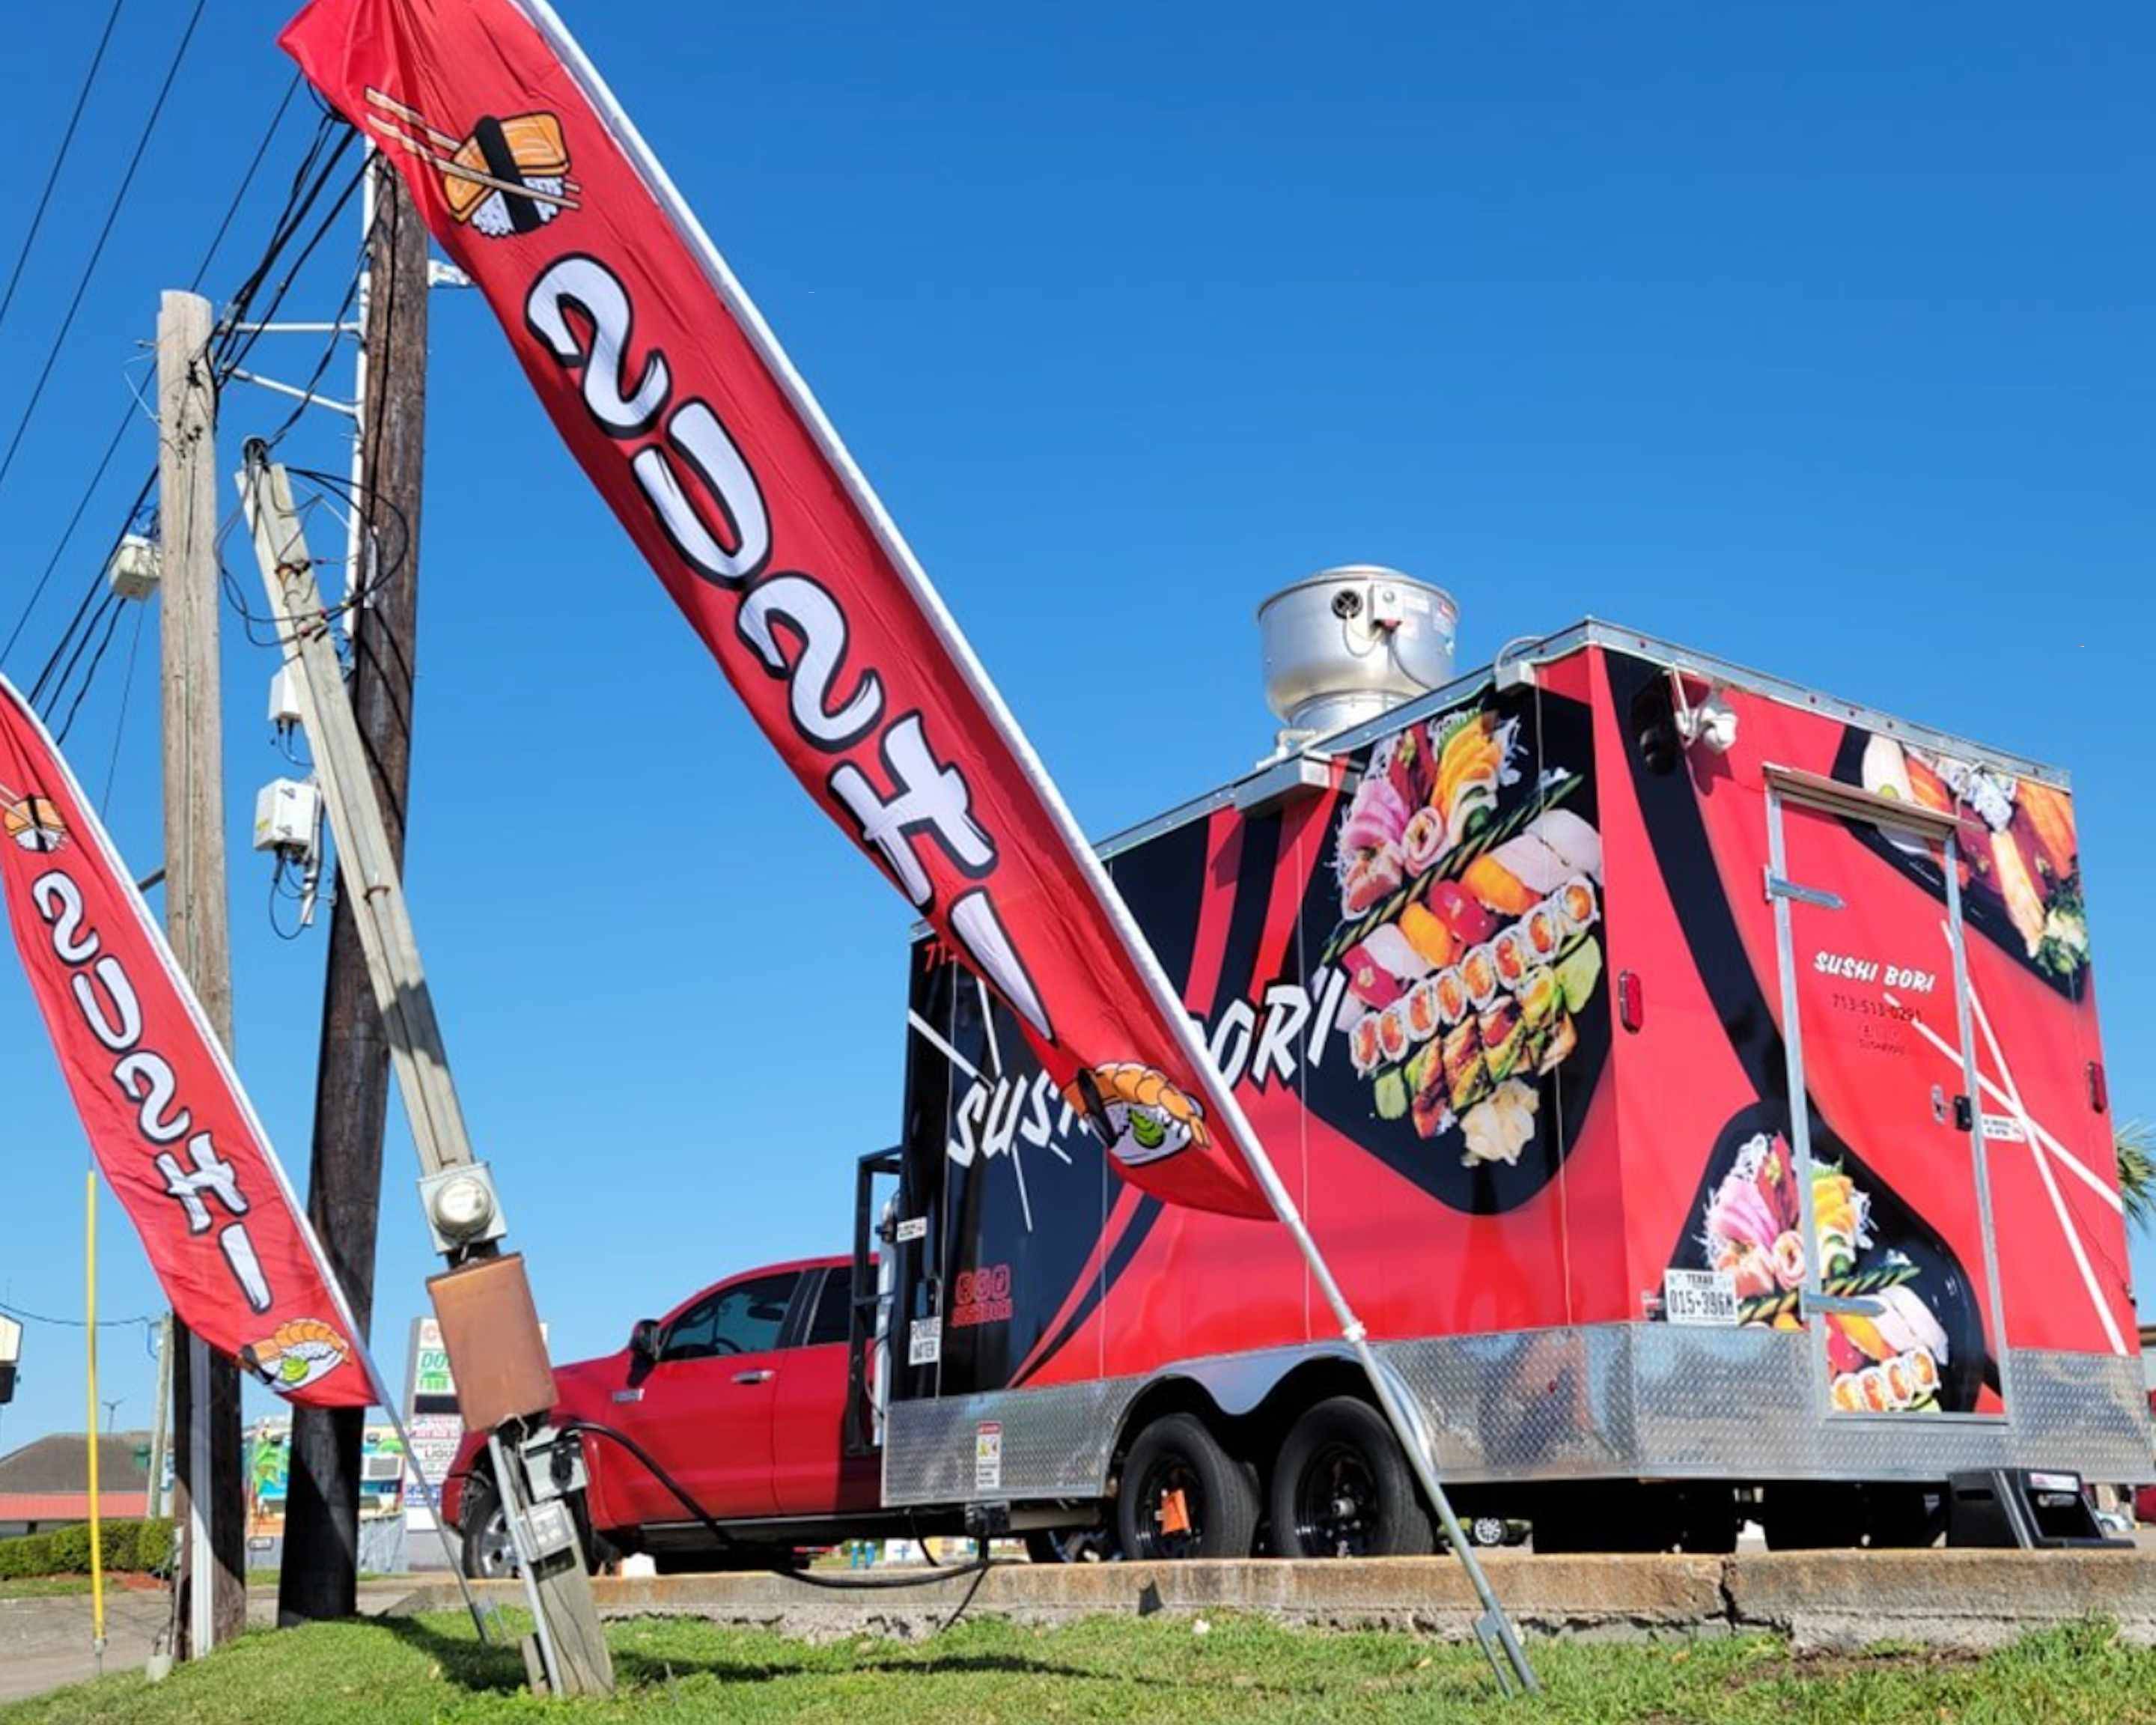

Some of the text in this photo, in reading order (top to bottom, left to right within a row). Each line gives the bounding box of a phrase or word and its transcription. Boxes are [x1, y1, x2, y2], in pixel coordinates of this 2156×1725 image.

[1813, 950, 1937, 993] SUSHI BORI
[946, 967, 1347, 1168] SUS ORI
